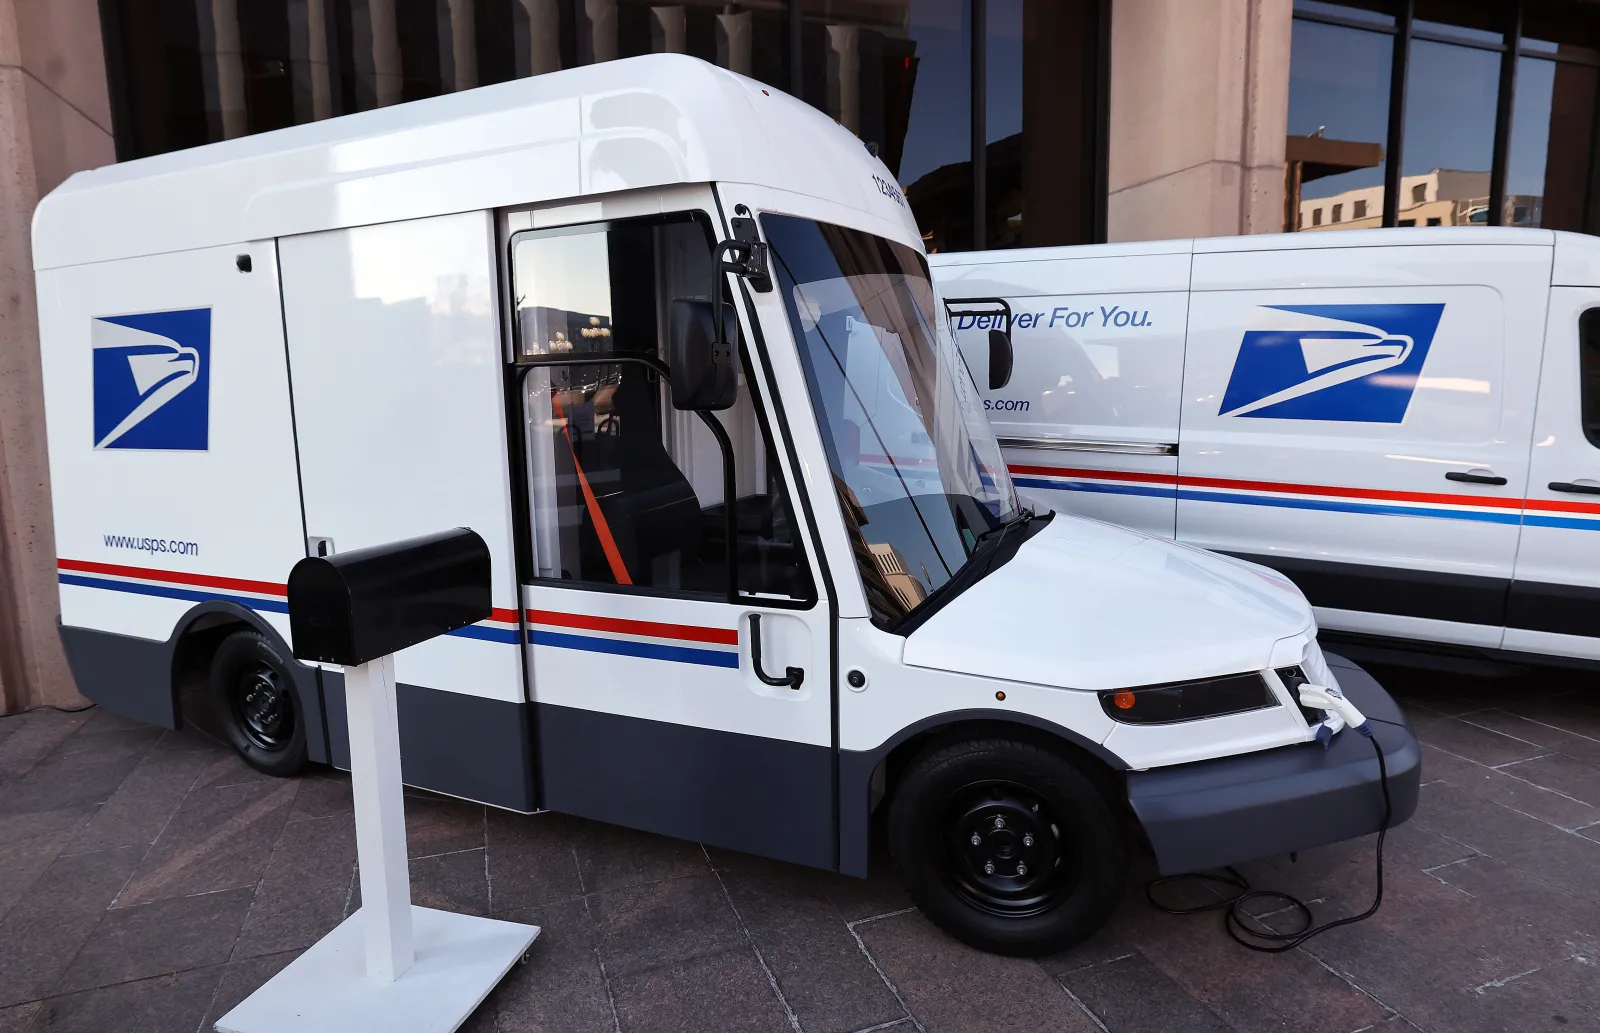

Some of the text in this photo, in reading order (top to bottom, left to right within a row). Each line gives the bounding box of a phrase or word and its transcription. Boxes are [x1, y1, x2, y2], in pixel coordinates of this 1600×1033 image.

[1049, 307, 1094, 328] For
[1100, 305, 1153, 327] You.
[103, 534, 199, 556] www.usps.com
